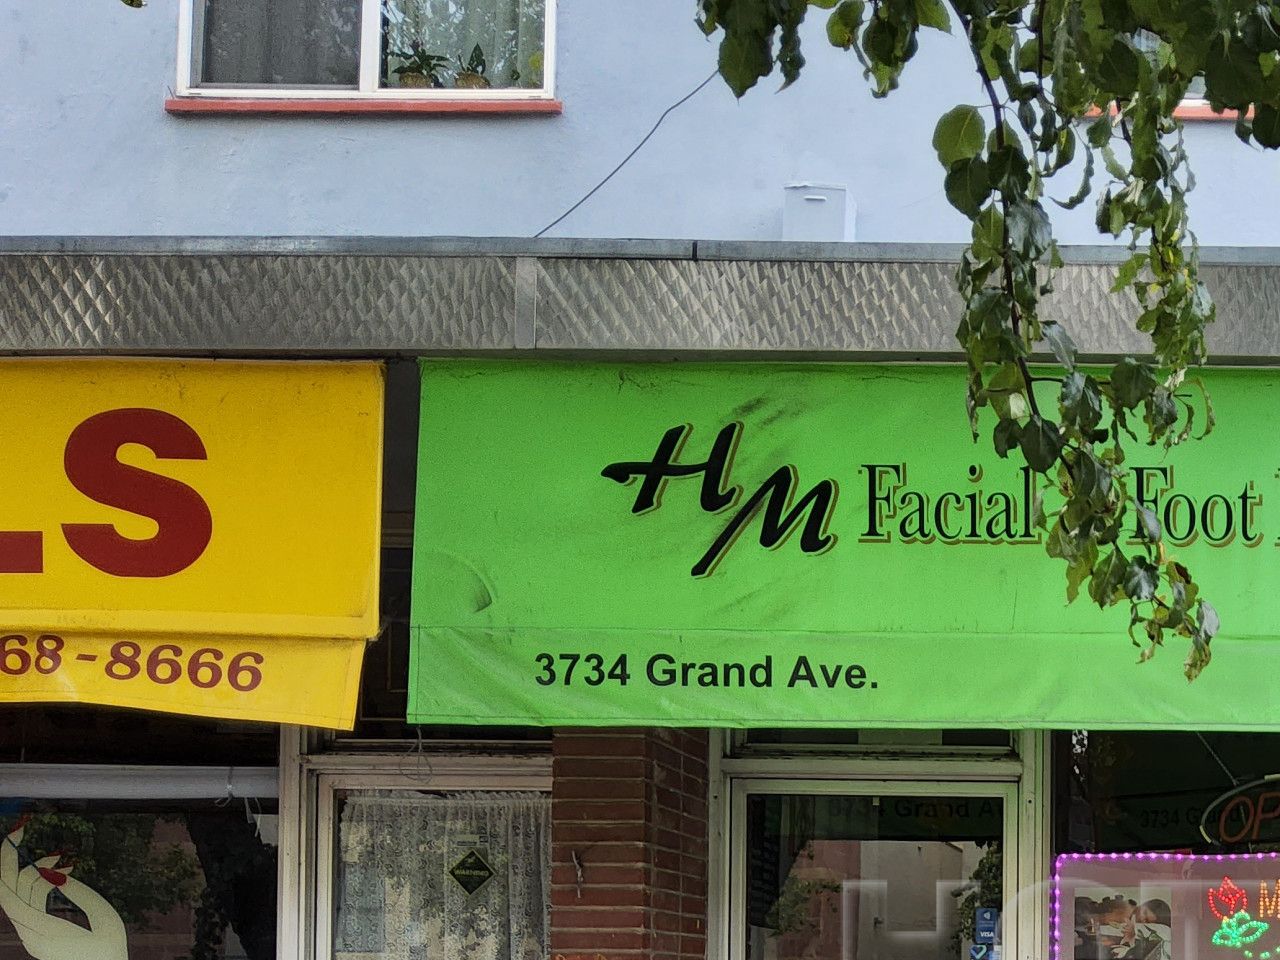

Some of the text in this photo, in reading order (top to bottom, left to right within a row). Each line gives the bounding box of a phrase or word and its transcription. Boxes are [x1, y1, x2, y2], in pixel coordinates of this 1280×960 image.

[858, 462, 1042, 546] Facial
[1127, 466, 1264, 548] Foot
[534, 652, 879, 689] 3734 Grand Ave.
